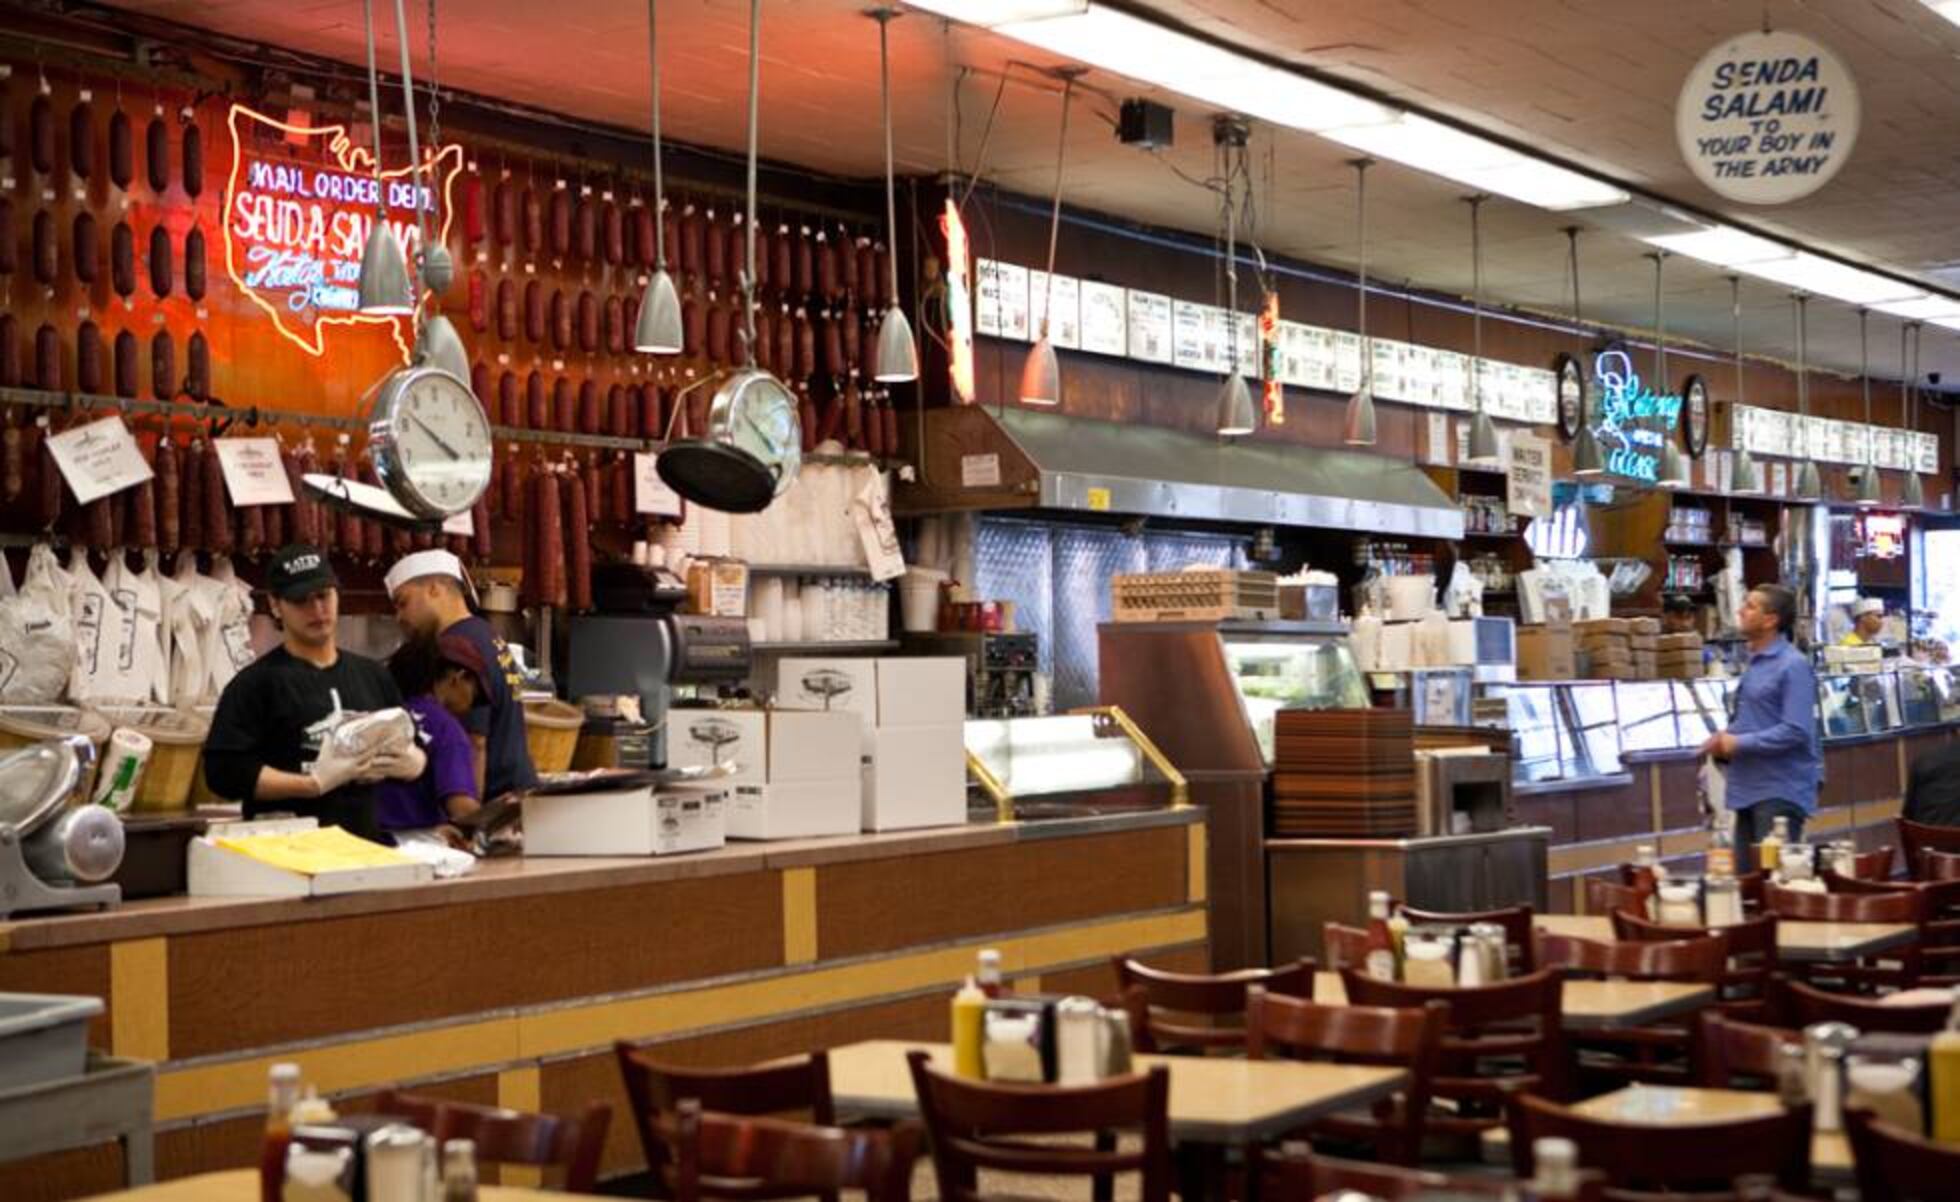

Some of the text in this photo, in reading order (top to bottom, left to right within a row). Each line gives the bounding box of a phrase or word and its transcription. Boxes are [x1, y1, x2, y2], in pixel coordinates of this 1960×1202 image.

[1749, 119, 1780, 134] TO
[1697, 131, 1836, 156] YOUR BOY IN
[1712, 155, 1829, 178] THE ARMY
[314, 173, 379, 204] ORDER
